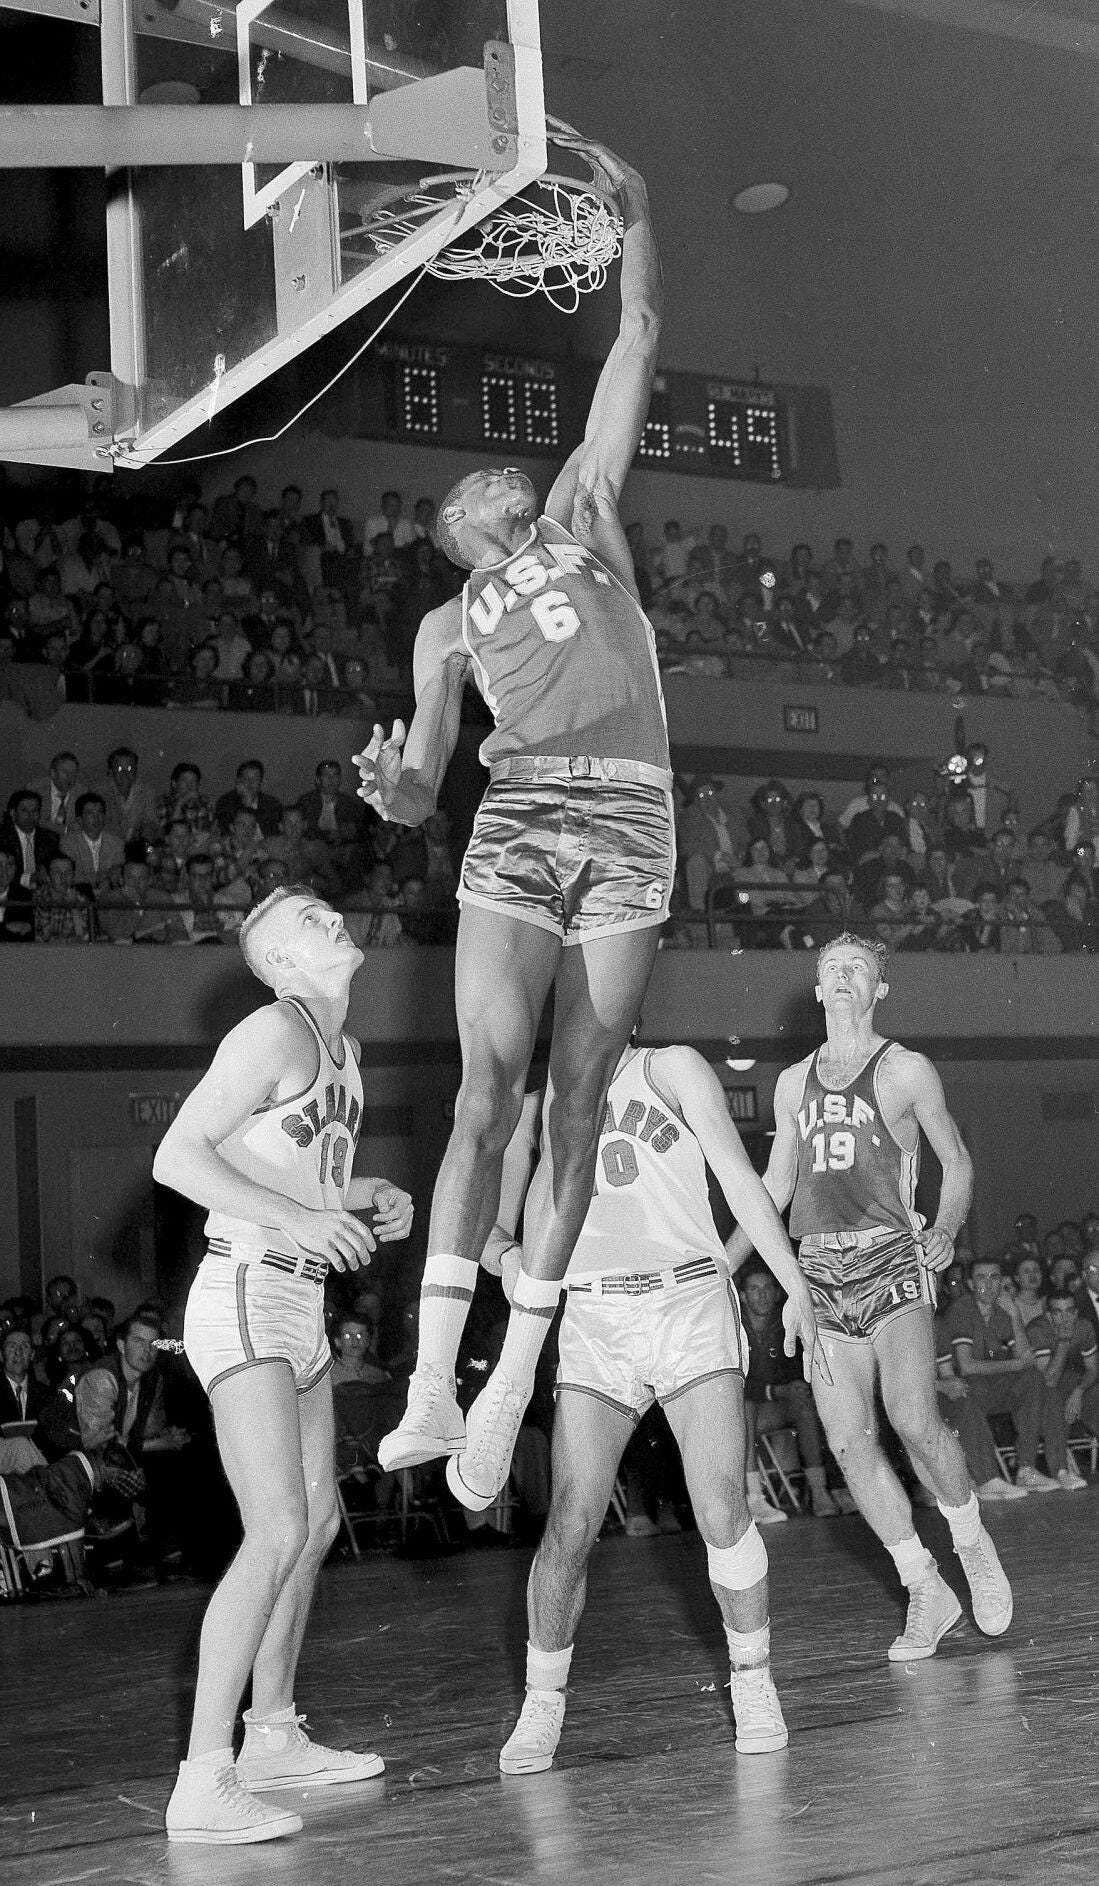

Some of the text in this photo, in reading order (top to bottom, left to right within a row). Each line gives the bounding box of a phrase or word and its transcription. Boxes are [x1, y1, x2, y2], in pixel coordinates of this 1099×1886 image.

[404, 367, 558, 445] 8 08
[707, 403, 777, 470] 49
[468, 543, 611, 636] U.S.F.
[530, 589, 581, 643] 6
[645, 882, 664, 910] 6
[138, 1097, 175, 1123] EXIT
[726, 1091, 753, 1118] XIT
[319, 1132, 348, 1189] 19
[593, 1139, 639, 1195] 0
[811, 1131, 855, 1173] 19
[889, 1280, 918, 1304] 19
